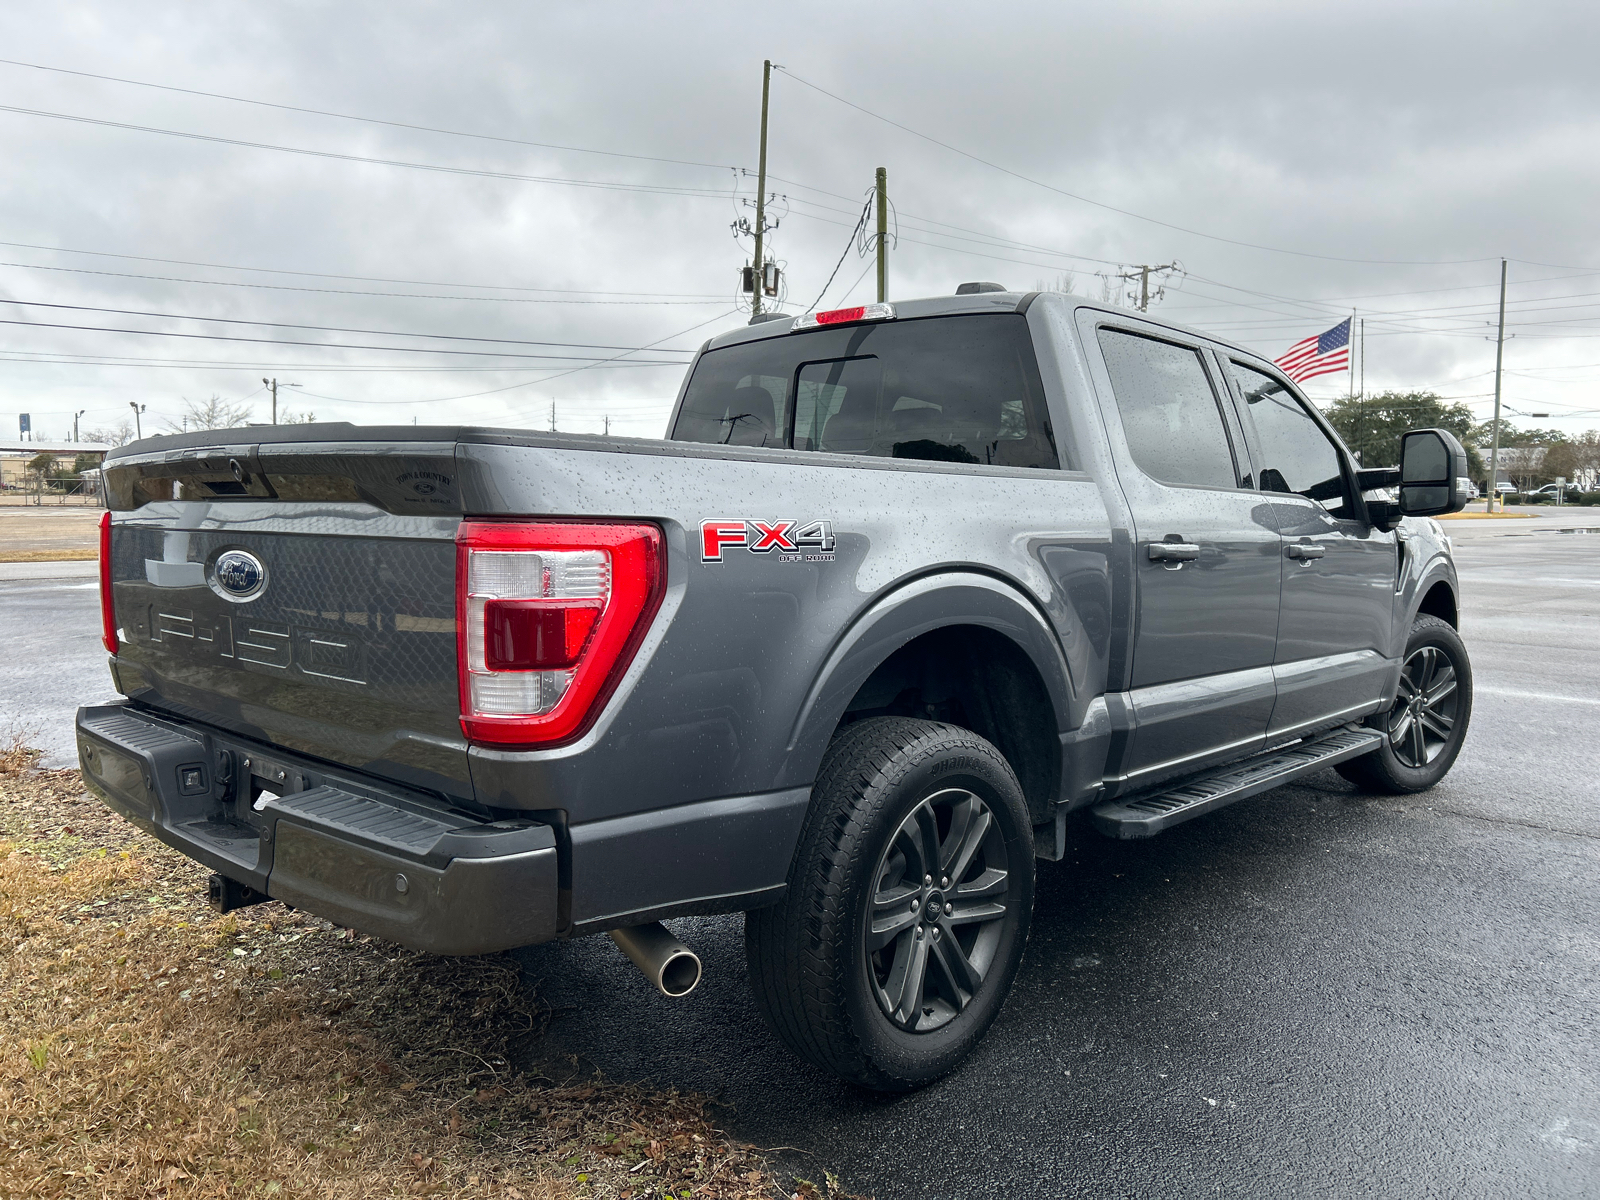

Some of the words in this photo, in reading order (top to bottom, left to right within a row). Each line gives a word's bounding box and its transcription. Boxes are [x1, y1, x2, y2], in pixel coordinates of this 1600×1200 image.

[396, 472, 414, 485] TOWN
[414, 471, 419, 479] &
[419, 471, 451, 486] COUNTRY
[699, 518, 836, 564] FX4
[779, 555, 802, 563] OFF
[805, 554, 836, 563] ROAD
[220, 559, 249, 586] Ford
[149, 603, 368, 686] F-150
